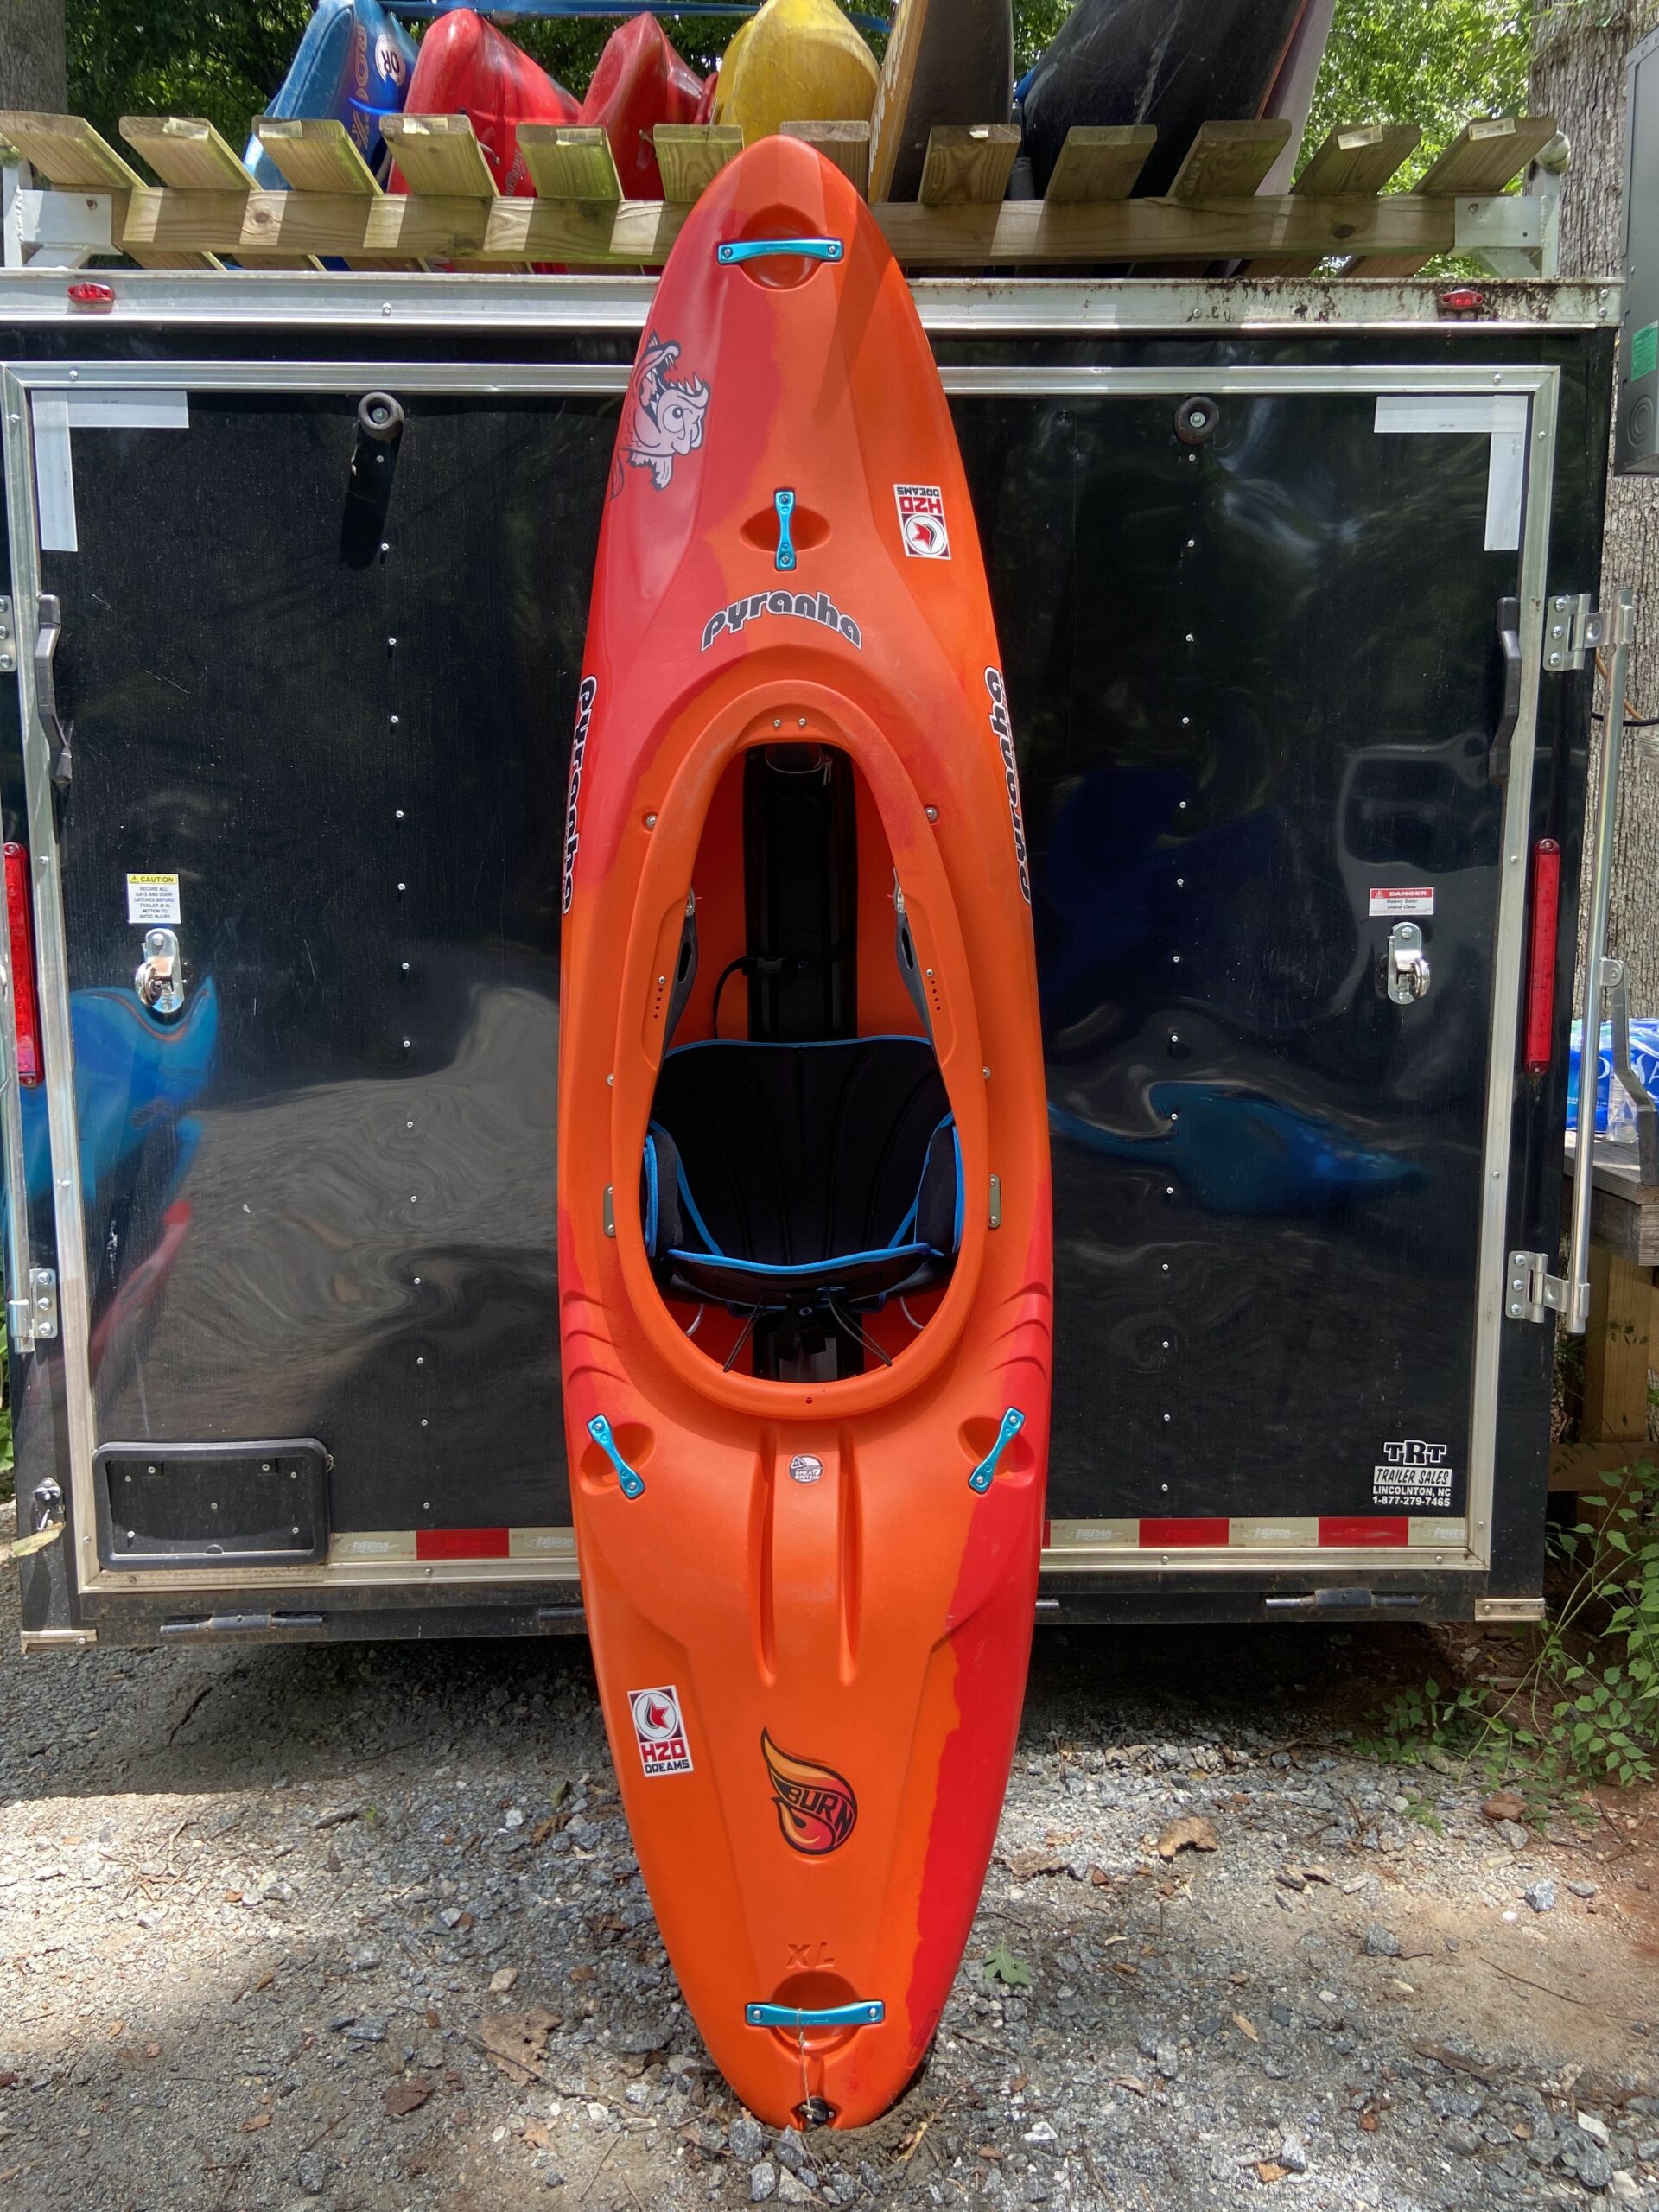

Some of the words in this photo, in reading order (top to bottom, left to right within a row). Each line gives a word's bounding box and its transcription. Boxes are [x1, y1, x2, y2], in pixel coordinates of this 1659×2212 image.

[380, 49, 400, 73] OR
[896, 486, 940, 497] DREAMS
[899, 496, 943, 515] H2O
[701, 589, 862, 652] pyranha
[1383, 1440, 1446, 1465] TRT
[1376, 1469, 1416, 1484] TRAILER
[1418, 1469, 1449, 1484] SALES
[1372, 1485, 1435, 1497] LINCOLNTON,
[1437, 1488, 1451, 1497] NC
[1372, 1495, 1451, 1507] 1-877-279-7465
[640, 1738, 687, 1763] H2O
[645, 1758, 690, 1774] DREAMS
[781, 1785, 853, 1842] BURN
[785, 1941, 835, 1969] XL
